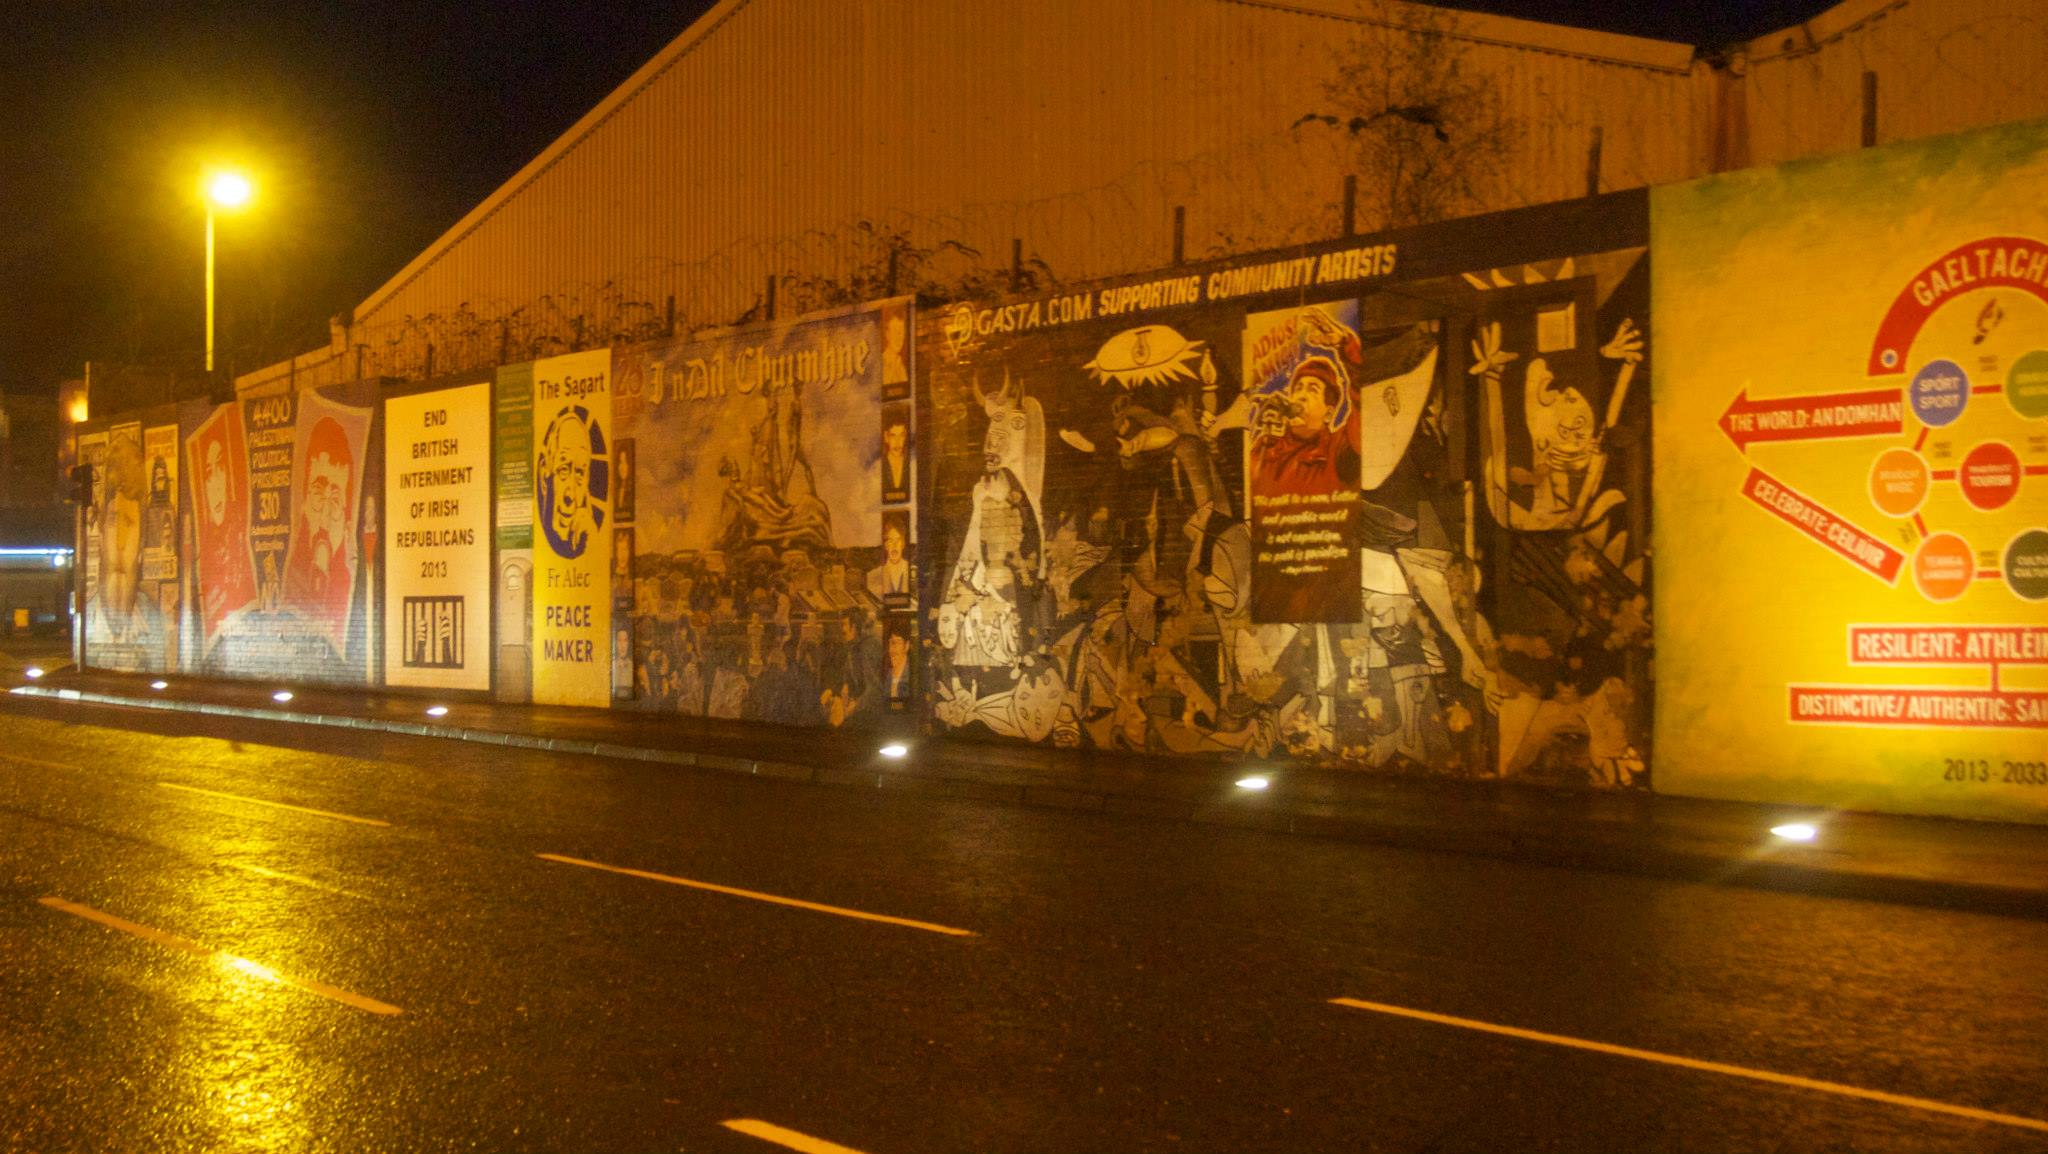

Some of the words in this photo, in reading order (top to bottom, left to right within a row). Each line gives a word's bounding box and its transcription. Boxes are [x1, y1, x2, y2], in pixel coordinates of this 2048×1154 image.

[1913, 247, 2048, 307] GAELTACH
[978, 292, 1092, 335] GASTA.COM
[1098, 275, 1200, 317] SUPPORTING
[1206, 255, 1317, 300] COMMUNITY
[1316, 243, 1398, 284] ARTISTS
[539, 379, 560, 400] The
[564, 372, 605, 400] Sagart
[253, 397, 291, 428] 4400
[1919, 394, 1961, 410] SPORT
[424, 409, 447, 427] END
[1728, 414, 1754, 433] THE
[1756, 410, 1810, 431] WORLD:
[1812, 408, 1834, 427] AN
[1835, 402, 1901, 426] DOMHAN
[412, 439, 458, 459] BRITISH
[400, 467, 473, 490] INTERNMENT
[410, 503, 424, 519] OF
[428, 500, 459, 518] IRISH
[396, 528, 475, 548] REPUBLICANS
[421, 561, 447, 578] 2013
[547, 567, 560, 589] Fr
[562, 567, 591, 589] Alec
[546, 605, 592, 628] PEACE
[544, 639, 593, 663] MAKER
[1858, 632, 1962, 659] RESILIENT:
[1798, 693, 1904, 717] DISTINCTIVE/
